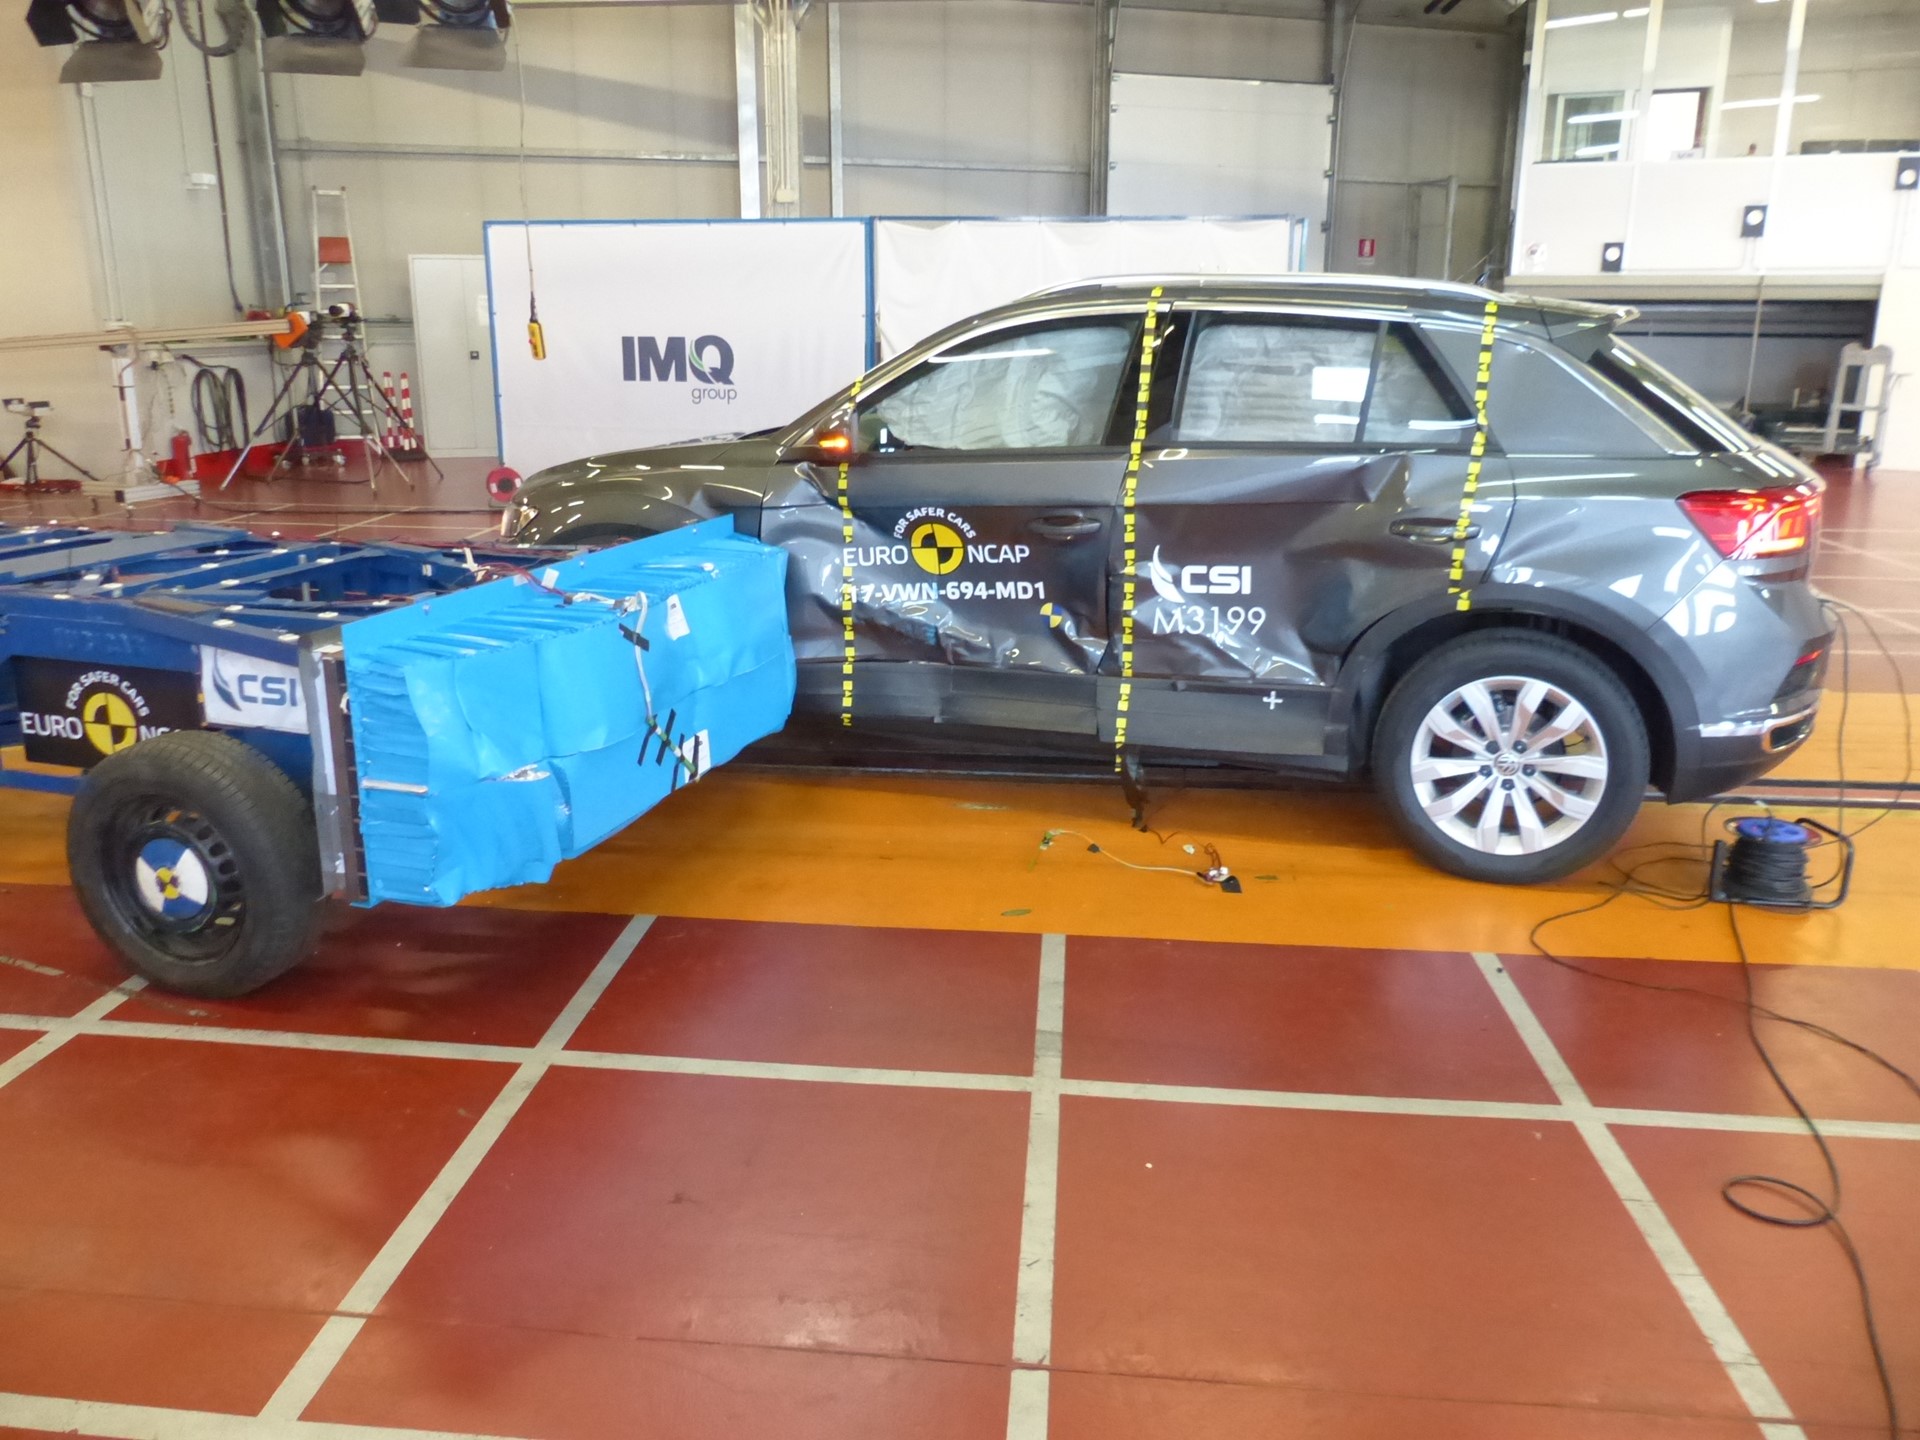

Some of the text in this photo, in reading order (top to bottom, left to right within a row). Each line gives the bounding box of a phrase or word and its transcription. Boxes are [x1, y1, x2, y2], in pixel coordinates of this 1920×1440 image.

[621, 335, 735, 385] IMQ
[691, 387, 738, 405] group
[893, 507, 977, 539] FOR SAFER CARS
[843, 544, 1030, 567] EURO NCAP
[848, 581, 1045, 603] 17-VWN-694-MD1
[1181, 565, 1252, 595] CSI
[1152, 605, 1266, 636] M3199
[65, 670, 150, 717] FOR SAFER CARS
[238, 674, 298, 707] CSI
[20, 711, 84, 740] EURO
